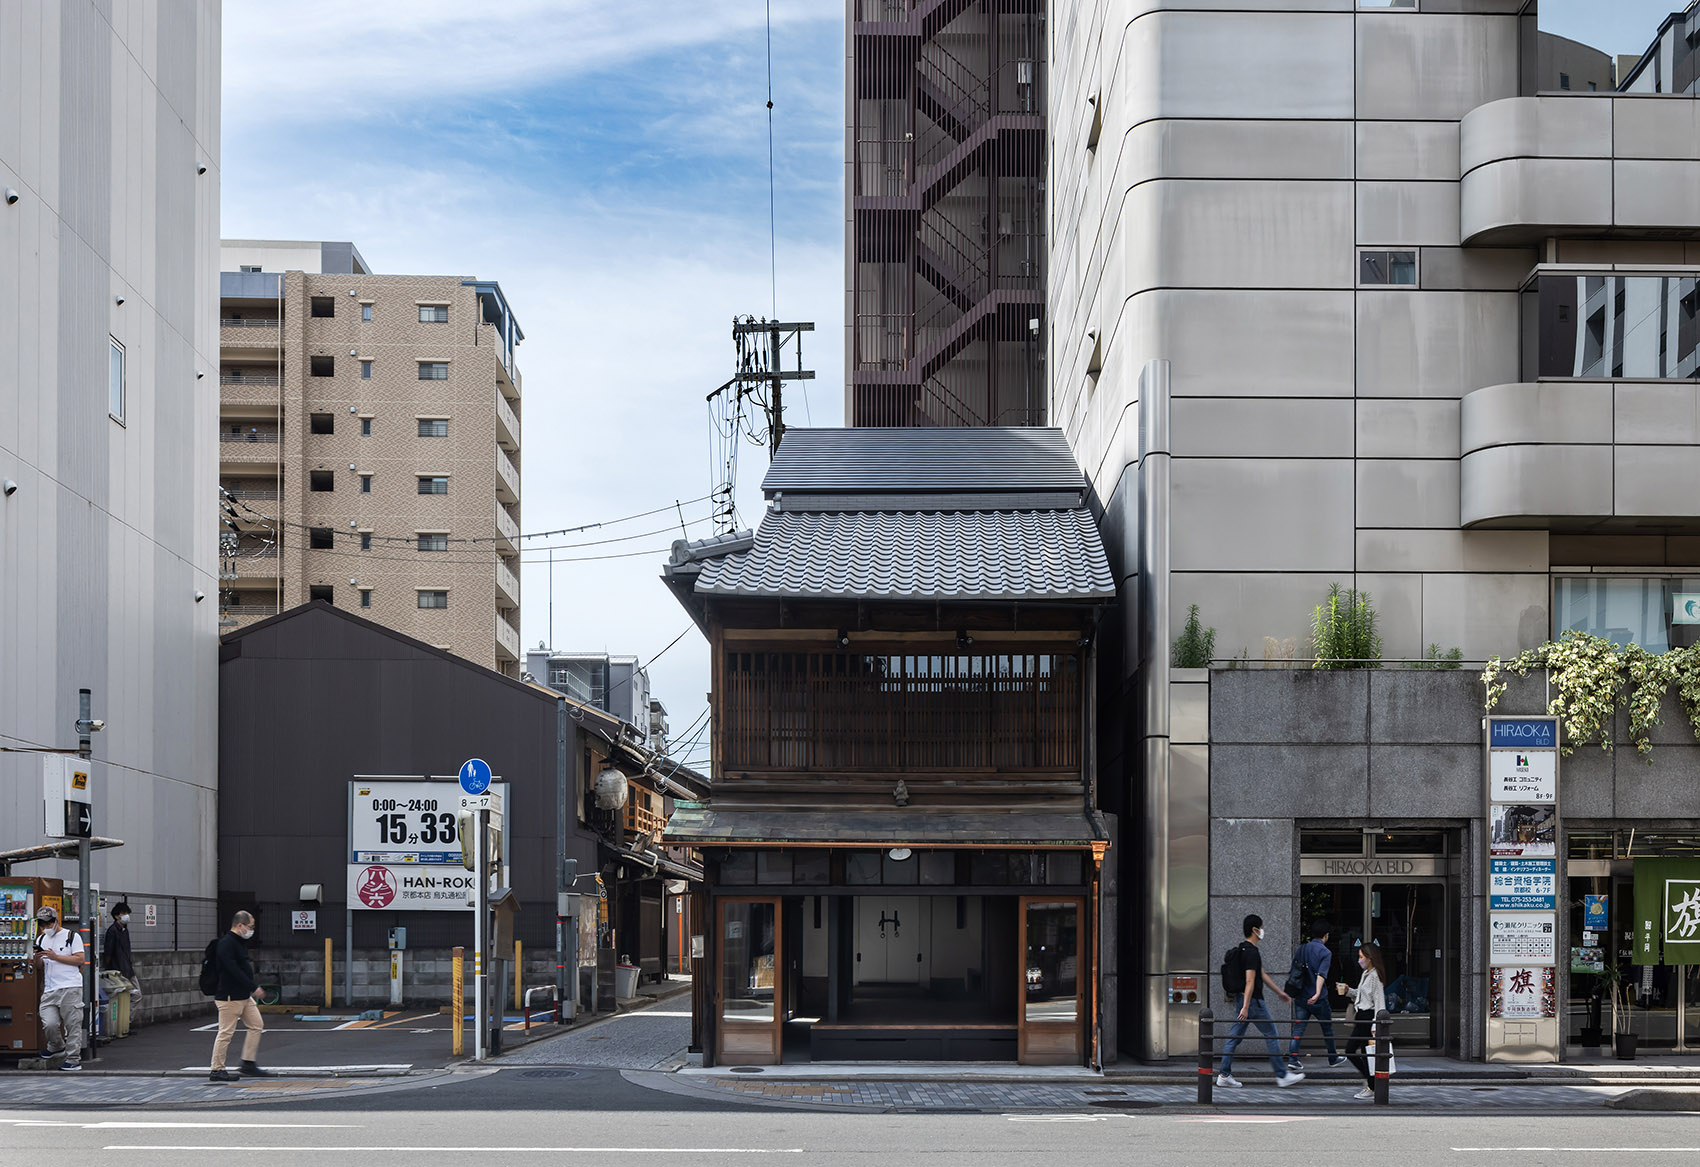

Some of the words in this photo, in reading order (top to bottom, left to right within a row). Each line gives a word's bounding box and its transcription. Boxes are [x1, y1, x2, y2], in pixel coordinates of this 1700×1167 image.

[1494, 724, 1550, 737] HIRAOKA
[1324, 860, 1383, 875] HIRAOKA
[1386, 860, 1413, 875] BLD
[403, 877, 475, 889] HAN-ROK
[1509, 969, 1535, 994] 旗
